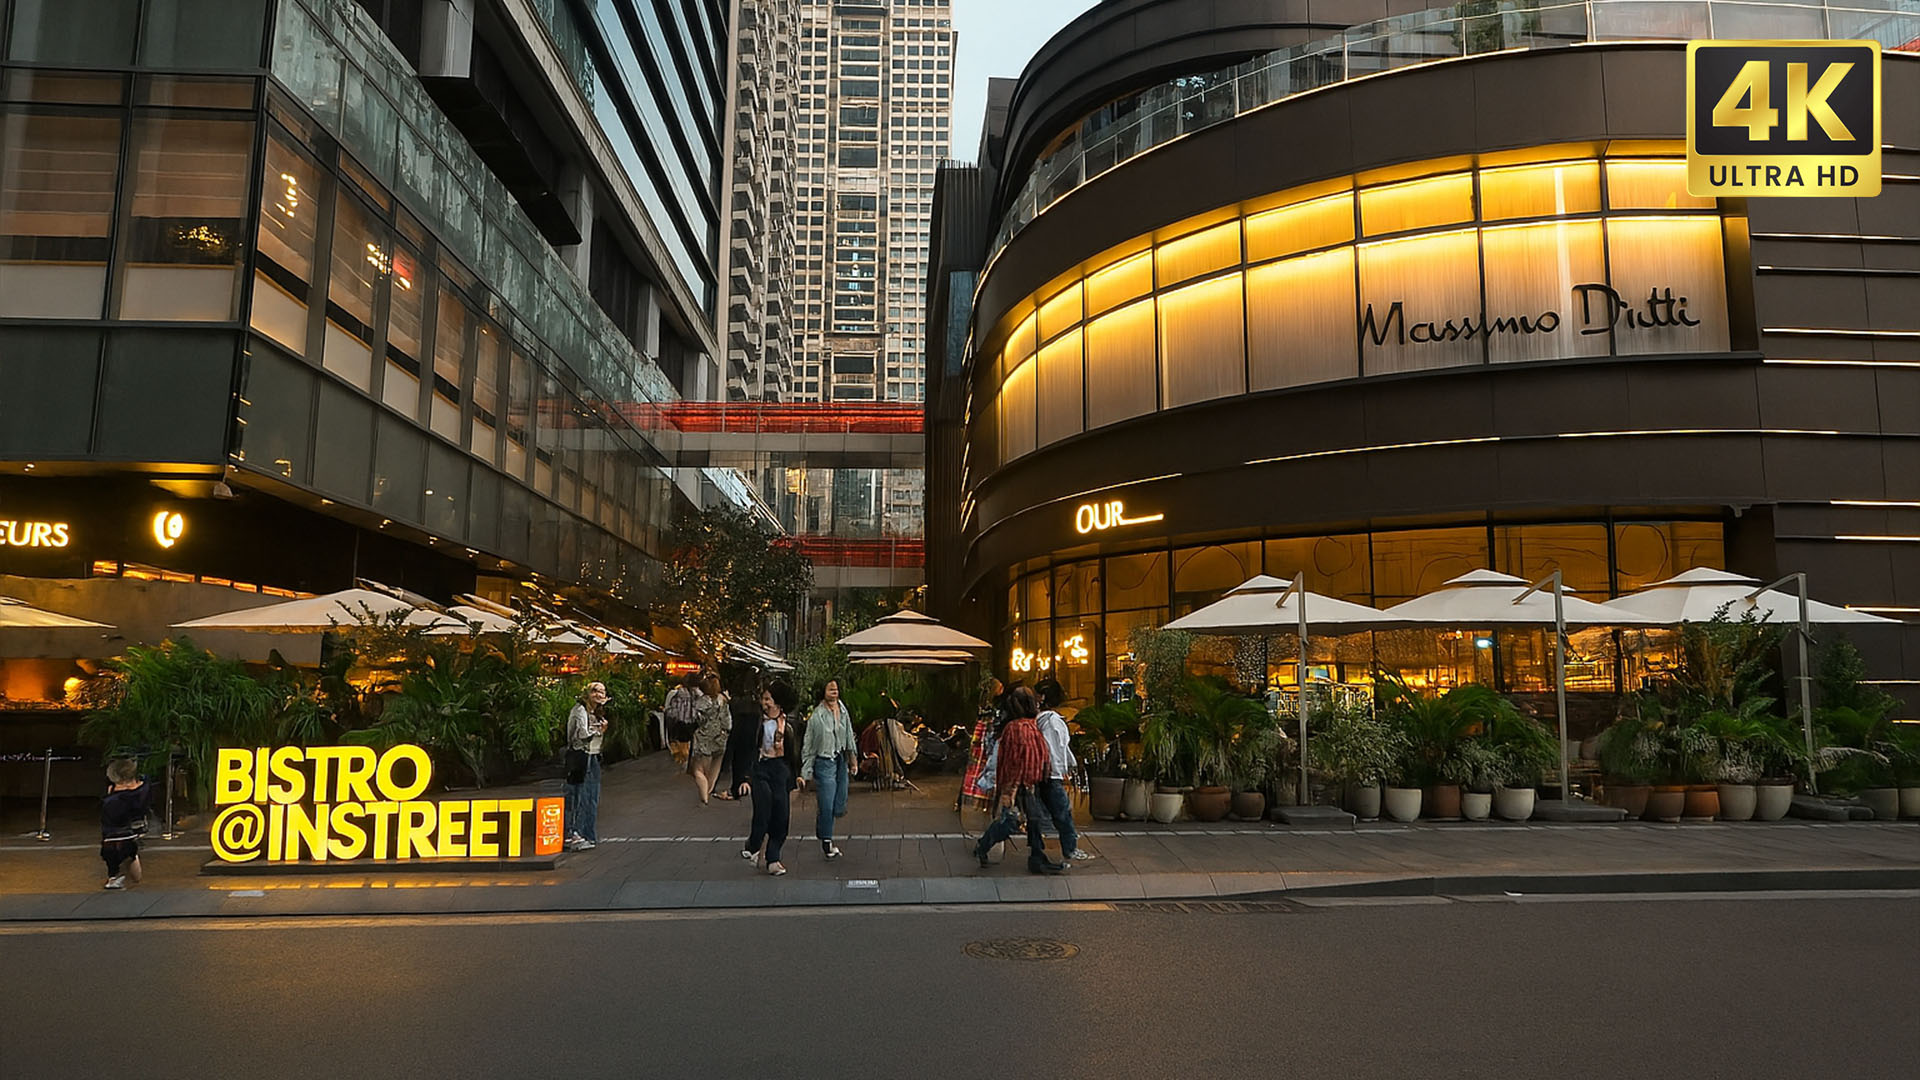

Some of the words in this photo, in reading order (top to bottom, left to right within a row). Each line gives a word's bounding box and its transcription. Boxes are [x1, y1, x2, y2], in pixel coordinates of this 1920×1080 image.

[1361, 301, 1560, 346] Massimo
[215, 744, 433, 804] BISTRO
[210, 798, 534, 862] @INSTREET
